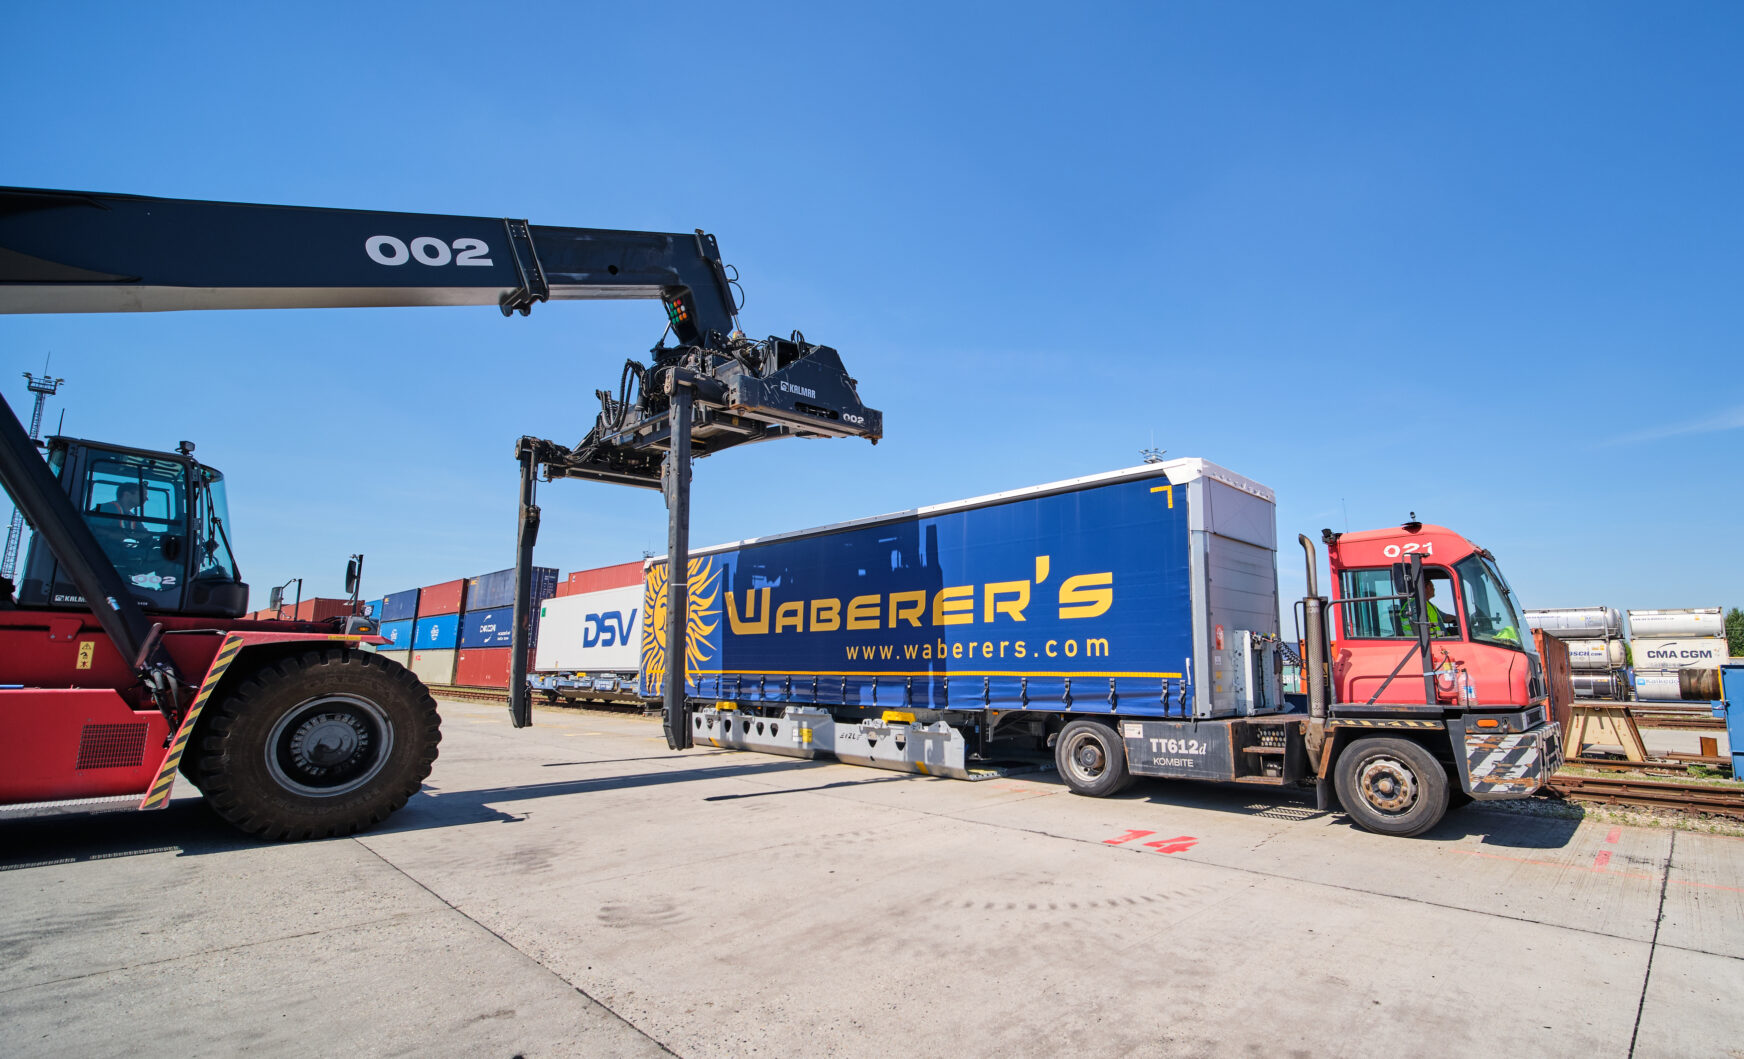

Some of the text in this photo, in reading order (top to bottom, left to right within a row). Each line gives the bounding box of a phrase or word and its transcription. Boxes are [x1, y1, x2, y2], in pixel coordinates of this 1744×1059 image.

[365, 235, 493, 266] 002
[843, 413, 864, 425] 002
[1383, 542, 1433, 558] 021
[724, 555, 1113, 635] WABERER'S
[583, 608, 638, 648] DSV
[846, 635, 1109, 660] www.waberers.com
[1647, 650, 1712, 658] CMA CGM
[1150, 738, 1207, 755] TT612d
[1153, 757, 1194, 767] KOMBITE
